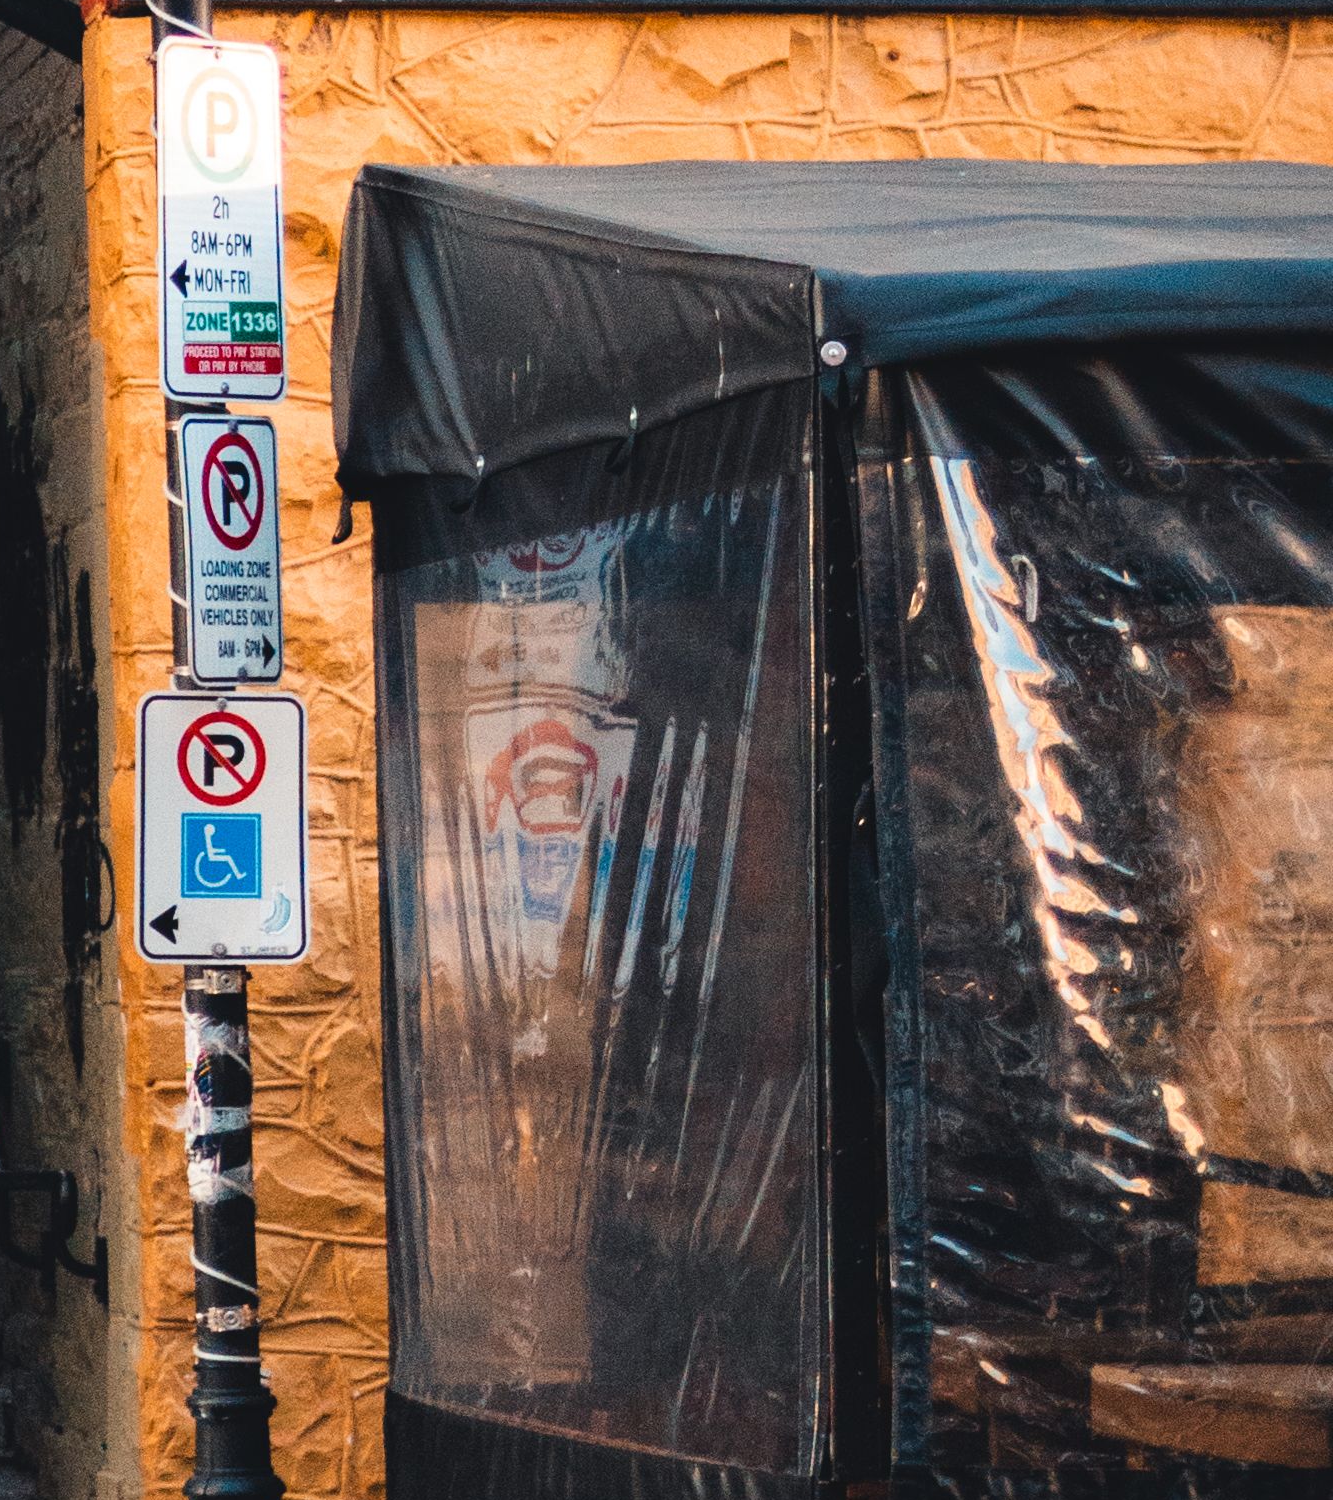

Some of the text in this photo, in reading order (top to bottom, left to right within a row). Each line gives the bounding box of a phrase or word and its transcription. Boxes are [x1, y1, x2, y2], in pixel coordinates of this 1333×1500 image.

[212, 195, 230, 219] 2h
[194, 267, 251, 295] MON-FRI
[186, 312, 277, 332] ZONE 1336
[184, 345, 281, 359] PROCEED TO PAY STATION
[198, 360, 267, 373] OR PAY BY PHONE
[200, 559, 271, 578] LOADING ZONE
[205, 584, 269, 603] COMMERCIAL
[200, 608, 274, 627] VEHICLES ONLY
